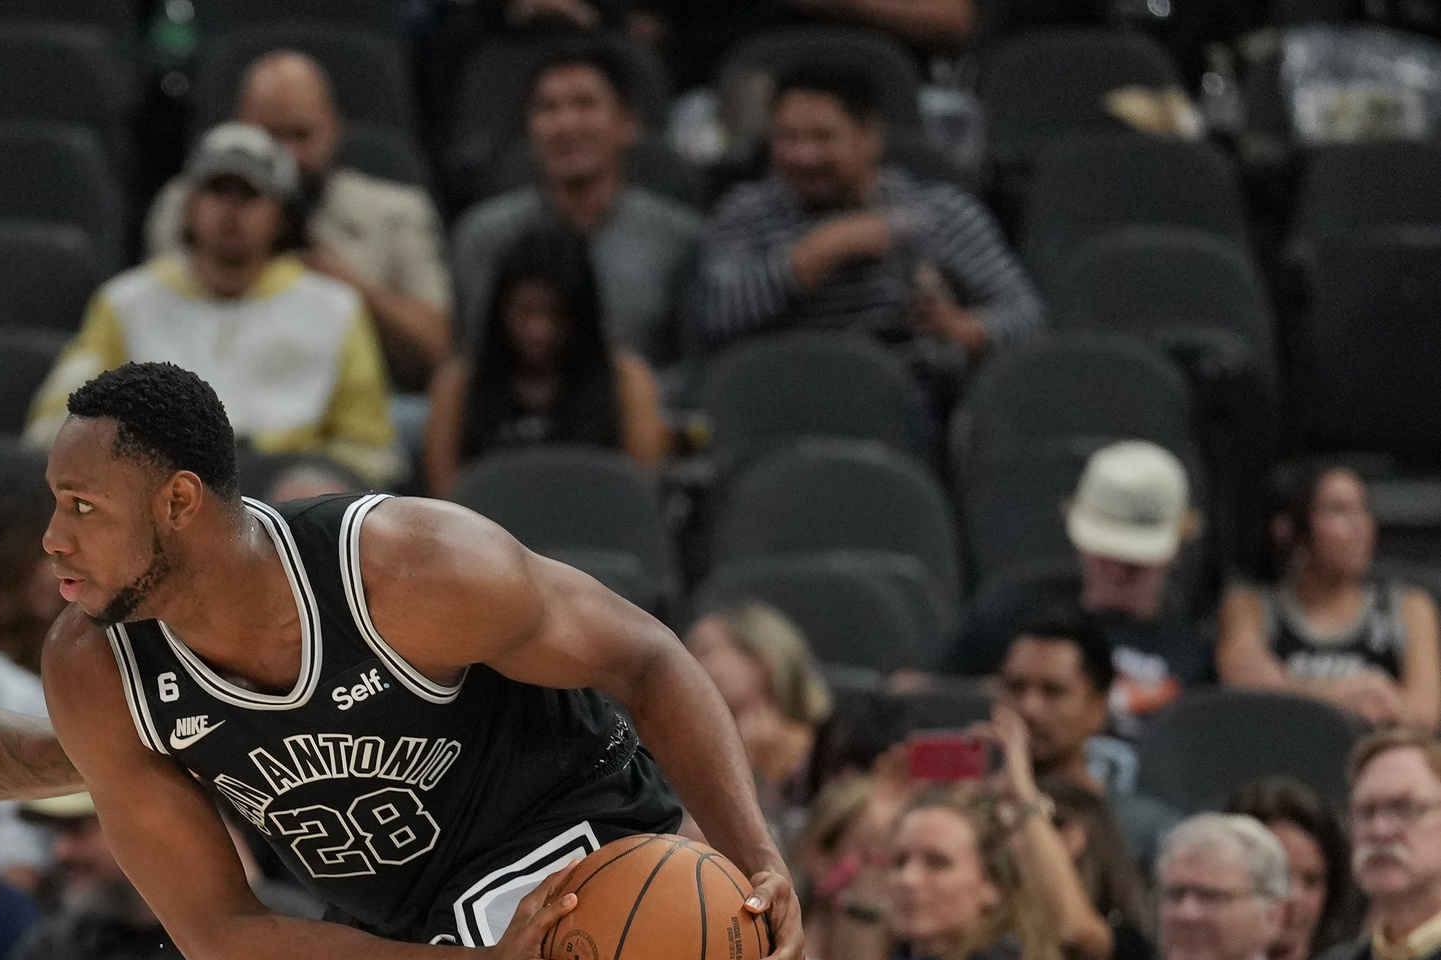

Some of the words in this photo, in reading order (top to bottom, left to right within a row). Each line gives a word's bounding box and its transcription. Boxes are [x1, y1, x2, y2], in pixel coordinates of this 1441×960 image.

[157, 671, 180, 703] 6
[175, 714, 209, 737] NIKE
[248, 732, 462, 796] ANTONIO
[268, 787, 441, 878] 28
